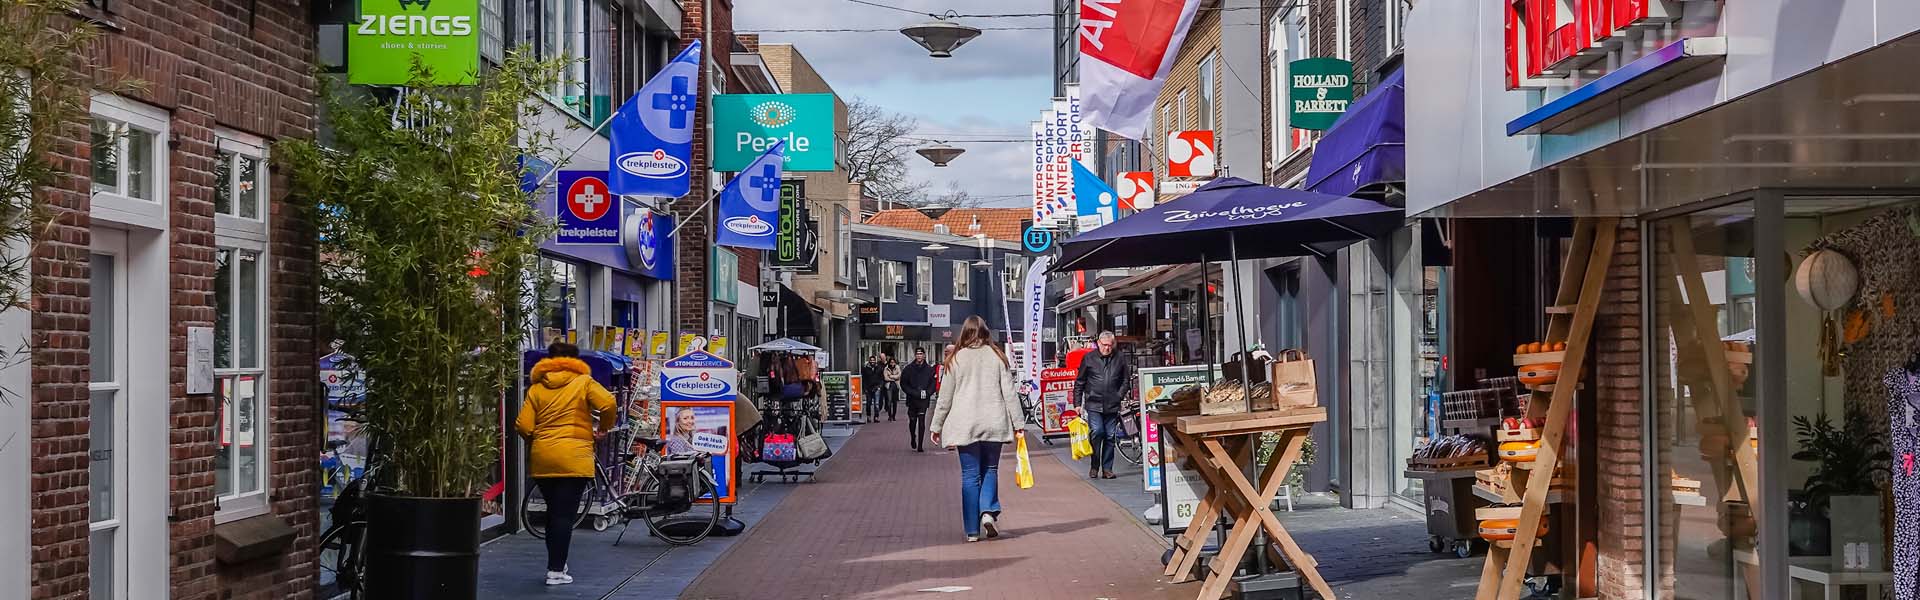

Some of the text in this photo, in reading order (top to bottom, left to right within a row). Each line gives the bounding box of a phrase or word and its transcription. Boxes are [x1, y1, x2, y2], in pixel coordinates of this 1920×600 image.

[358, 15, 472, 36] ZIENGS
[1293, 75, 1349, 88] HOLLAND
[1317, 87, 1328, 101] &
[1295, 100, 1348, 113] BARRETT
[1057, 111, 1068, 195] INTERSPORT
[626, 160, 678, 171] trekpleister
[1045, 121, 1054, 202] INTERSPORT
[1035, 132, 1043, 209] INTERSPORT
[559, 227, 619, 239] trekpleister
[1030, 232, 1044, 244] H
[1031, 283, 1042, 377] INTERSPORT
[675, 382, 721, 390] trekpleister
